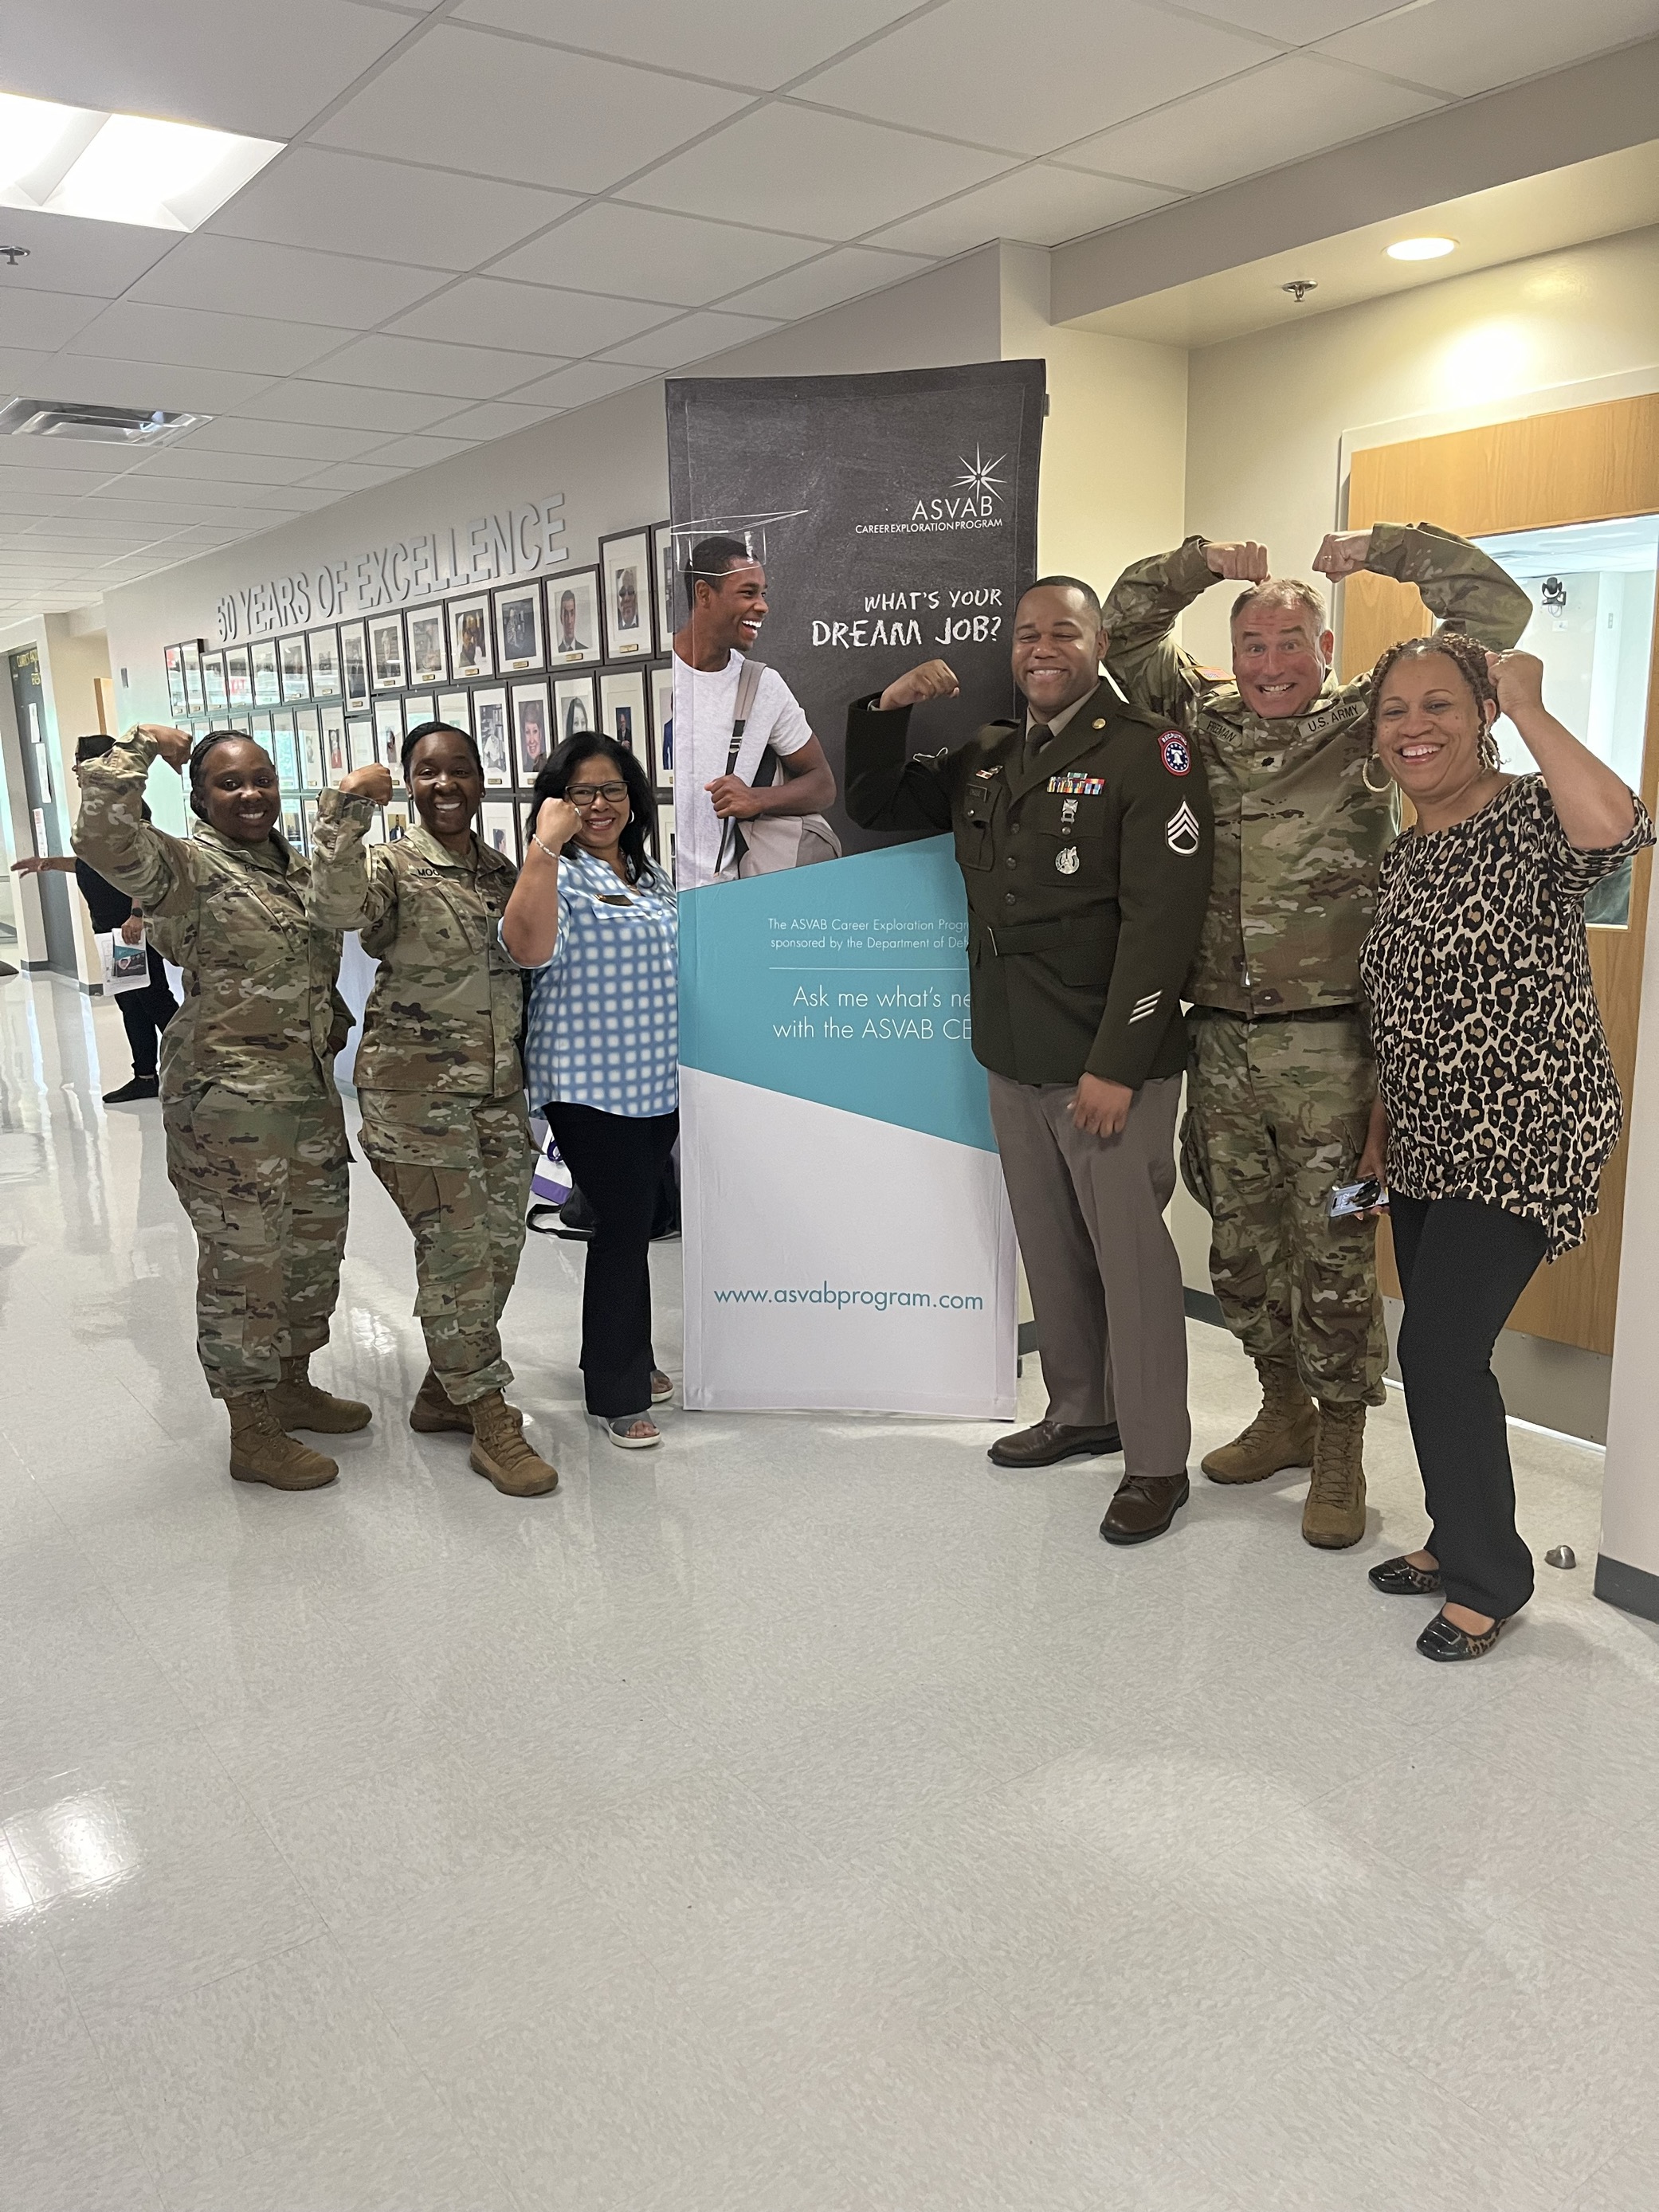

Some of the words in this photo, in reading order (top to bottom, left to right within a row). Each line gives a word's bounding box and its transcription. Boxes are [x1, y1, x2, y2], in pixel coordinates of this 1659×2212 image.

[912, 496, 993, 521] ASVAB
[855, 524, 890, 534] CAREER
[890, 521, 955, 533] EXPLORATION
[955, 518, 1003, 531] PROGRAM
[216, 593, 238, 642] 50
[239, 571, 312, 635] YEARS
[318, 561, 347, 618] OF
[358, 492, 569, 610] EXCELLENCE
[865, 590, 940, 613] WHAT'S
[949, 588, 1003, 608] YOUR
[812, 618, 923, 649] DREAM
[935, 615, 1002, 645] JOB?
[1308, 716, 1329, 732] U.S.
[1331, 704, 1359, 724] ARMY
[767, 918, 787, 930] The
[790, 918, 827, 931] ASVAB
[831, 919, 869, 931] Career
[873, 919, 934, 933] Exploration
[771, 936, 826, 950] sponsored
[830, 936, 843, 951] by
[847, 936, 863, 948] the
[867, 936, 929, 951] Department
[933, 936, 944, 948] of
[793, 984, 830, 1007] Ask
[838, 993, 869, 1007] me
[877, 984, 942, 1008] what's
[772, 1016, 814, 1038] with
[823, 1016, 853, 1039] the
[861, 1018, 934, 1040] ASVAB
[713, 1280, 983, 1312] www.asvabprogram.com
